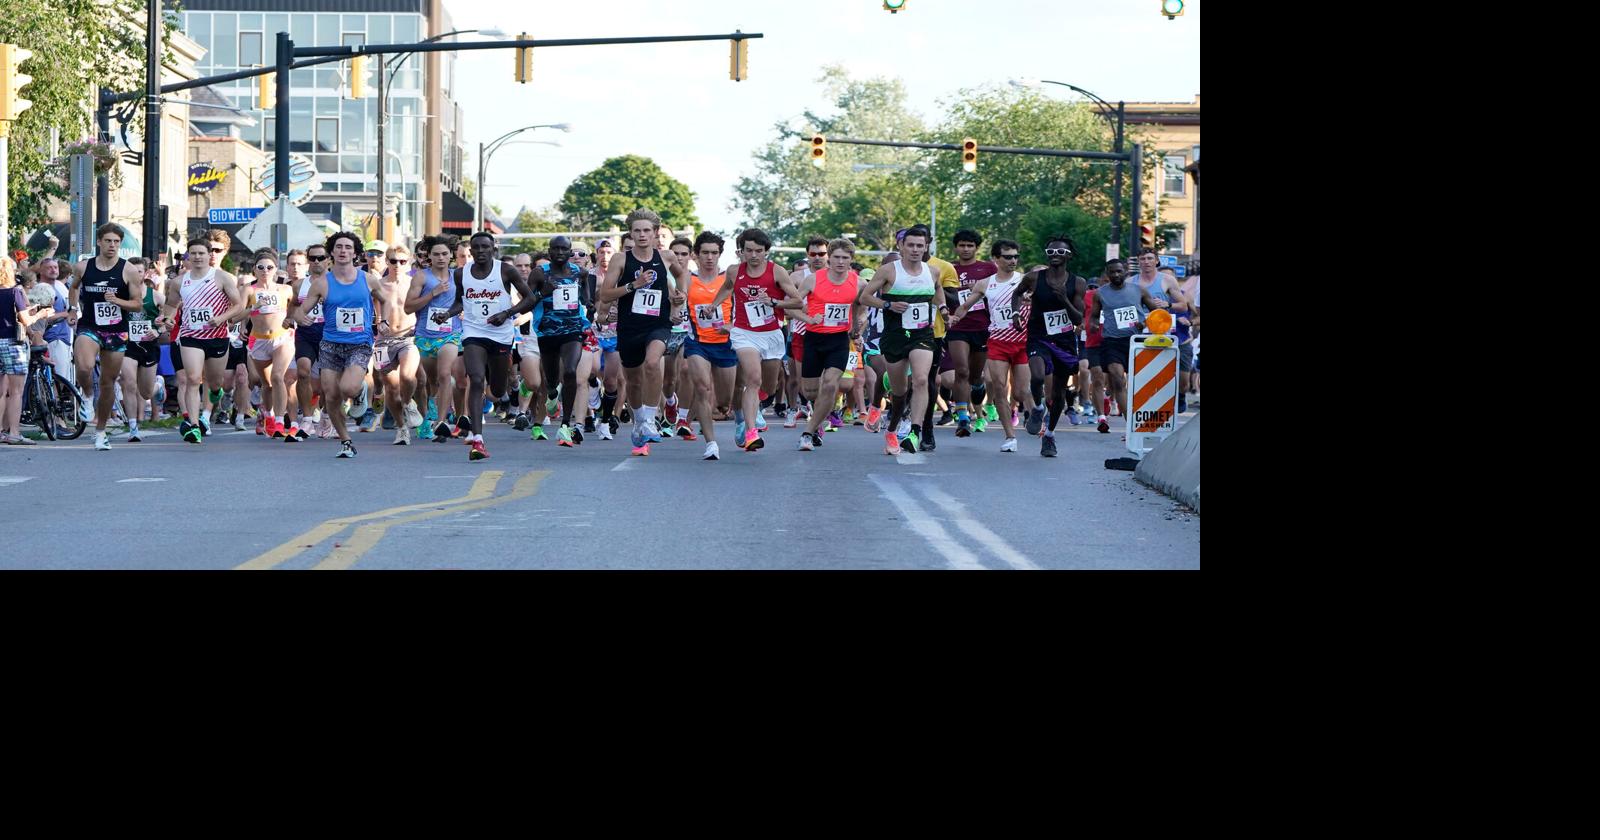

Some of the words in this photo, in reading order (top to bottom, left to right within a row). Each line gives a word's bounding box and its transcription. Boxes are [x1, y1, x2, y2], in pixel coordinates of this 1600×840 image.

[188, 167, 228, 185] hilly
[211, 210, 254, 221] BIDWELL
[465, 287, 501, 299] Cowboys
[562, 289, 570, 301] 5
[642, 293, 655, 306] 10
[97, 305, 118, 317] 592
[481, 303, 489, 316] 3
[753, 303, 767, 317] 11
[828, 307, 847, 319] 721
[912, 308, 920, 320] 9
[1117, 309, 1135, 322] 725
[190, 310, 210, 323] 546
[342, 312, 356, 324] 21
[1047, 313, 1069, 327] 270
[131, 324, 149, 335] 625
[1135, 411, 1171, 422] COMET
